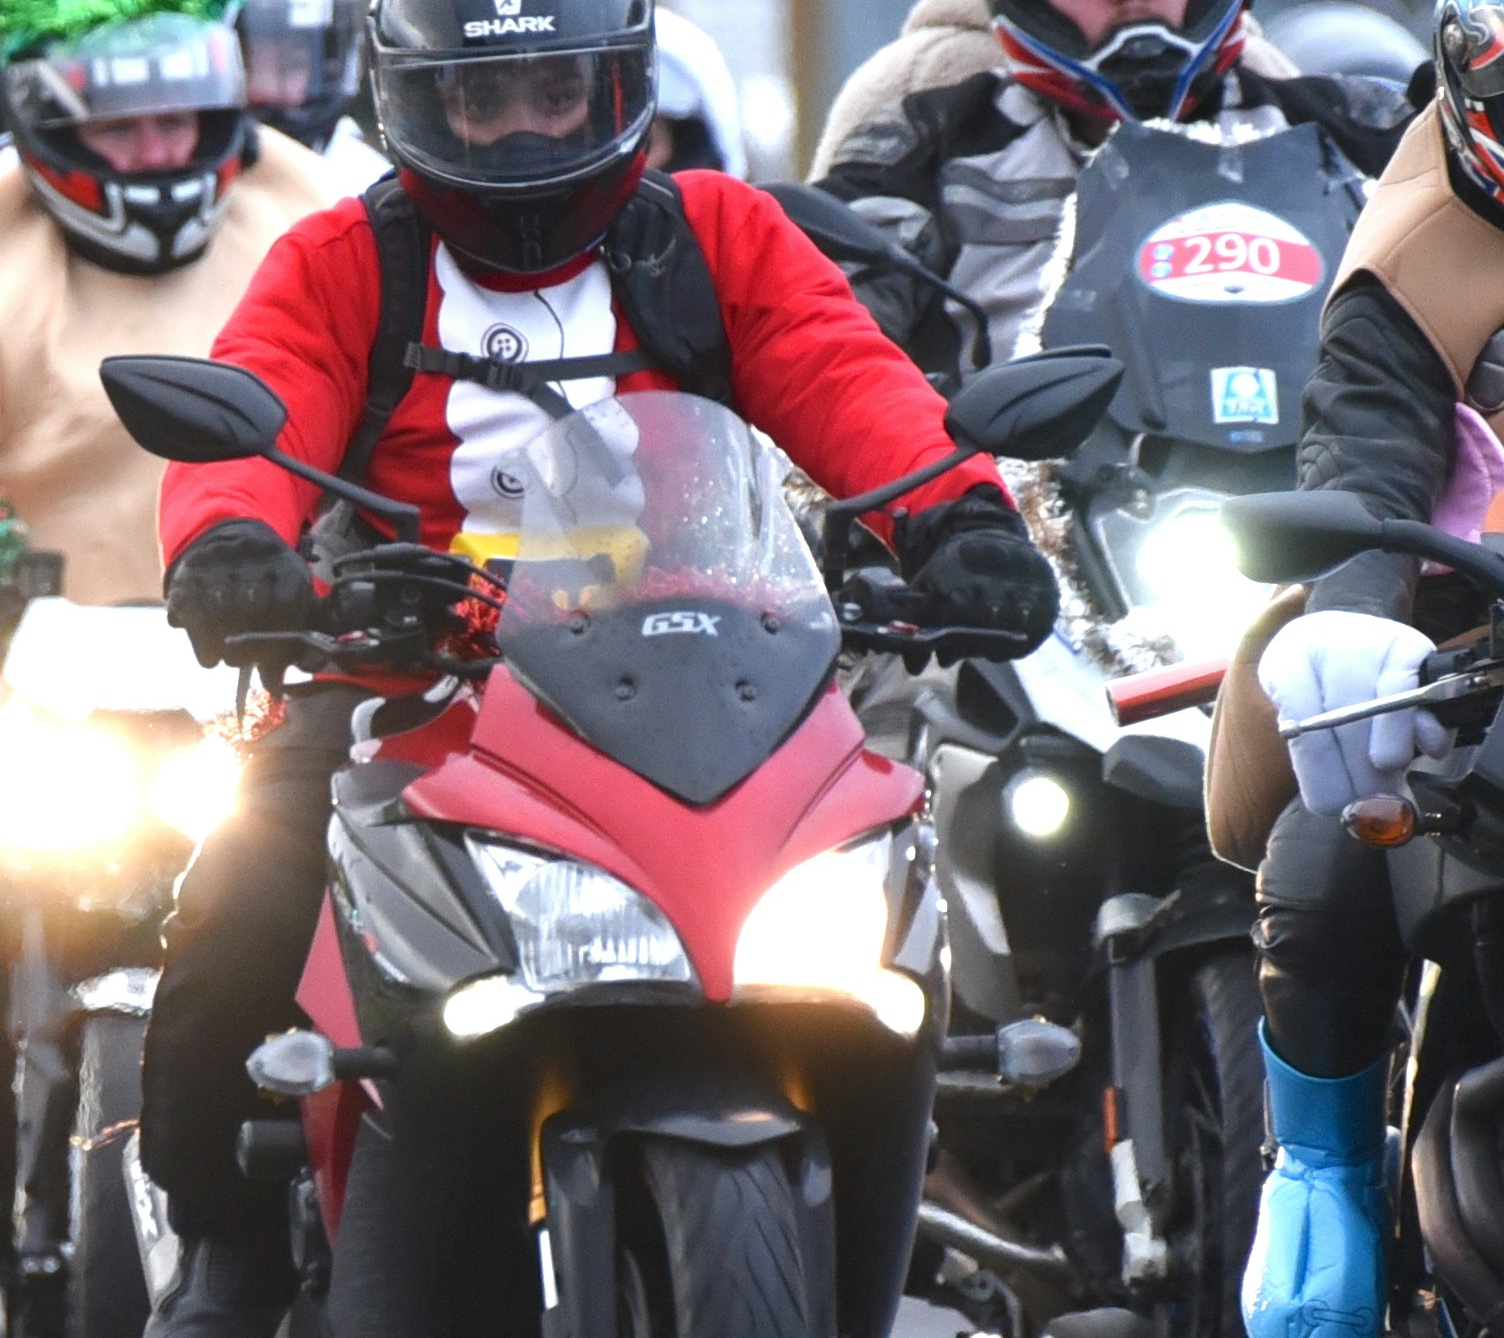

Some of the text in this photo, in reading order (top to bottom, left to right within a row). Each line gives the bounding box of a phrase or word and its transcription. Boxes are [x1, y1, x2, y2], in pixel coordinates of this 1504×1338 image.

[463, 16, 556, 38] SHARK
[1184, 233, 1281, 275] 290
[641, 612, 721, 637] GSX
